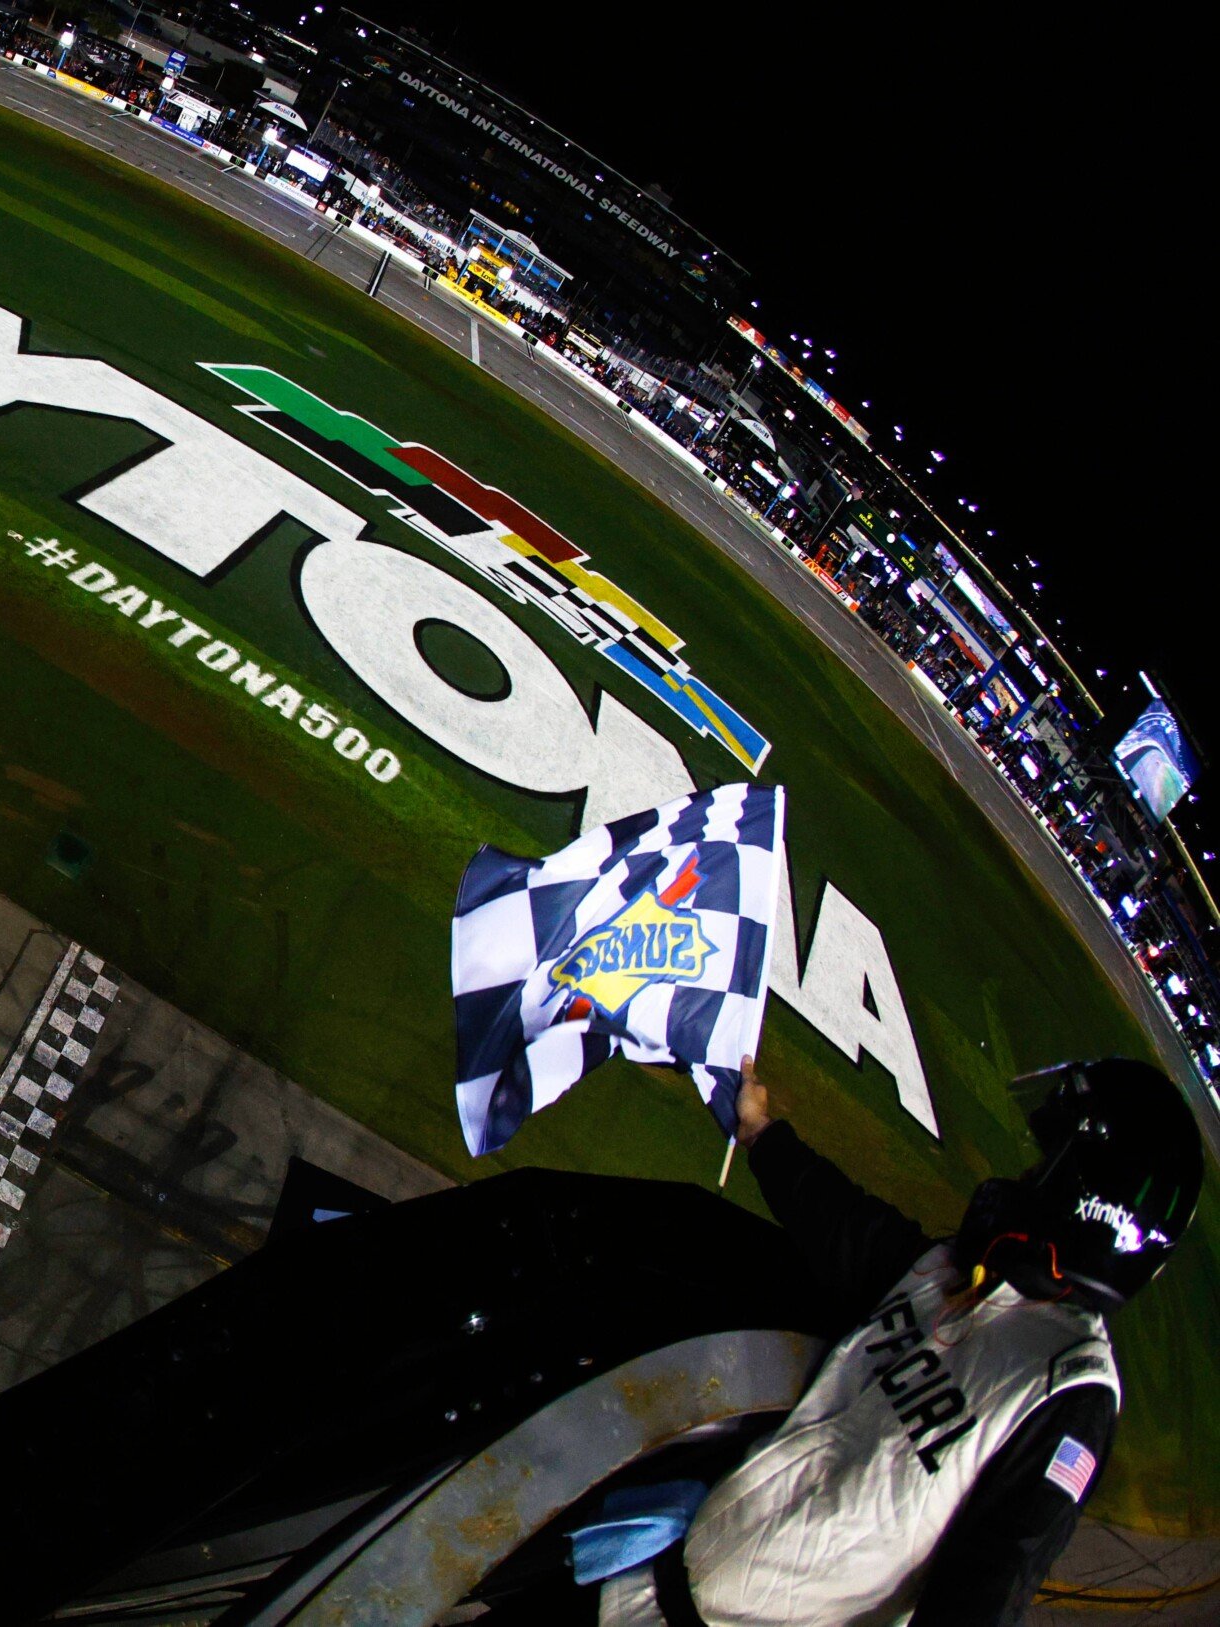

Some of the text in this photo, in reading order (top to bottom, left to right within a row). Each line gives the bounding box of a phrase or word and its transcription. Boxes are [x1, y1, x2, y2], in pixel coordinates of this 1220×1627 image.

[274, 104, 291, 117] Mobil
[398, 71, 680, 260] DAYTONA INTERNATIONAL SPEEDWAY
[423, 231, 447, 252] Mobil
[480, 270, 497, 284] Love
[833, 406, 848, 421] TOYOTA
[752, 422, 766, 437] Mobil
[859, 512, 873, 530] ROLEX
[900, 555, 915, 571] ROLEX
[24, 536, 402, 783] #DAYTONA500
[1075, 1194, 1135, 1233] xfinity
